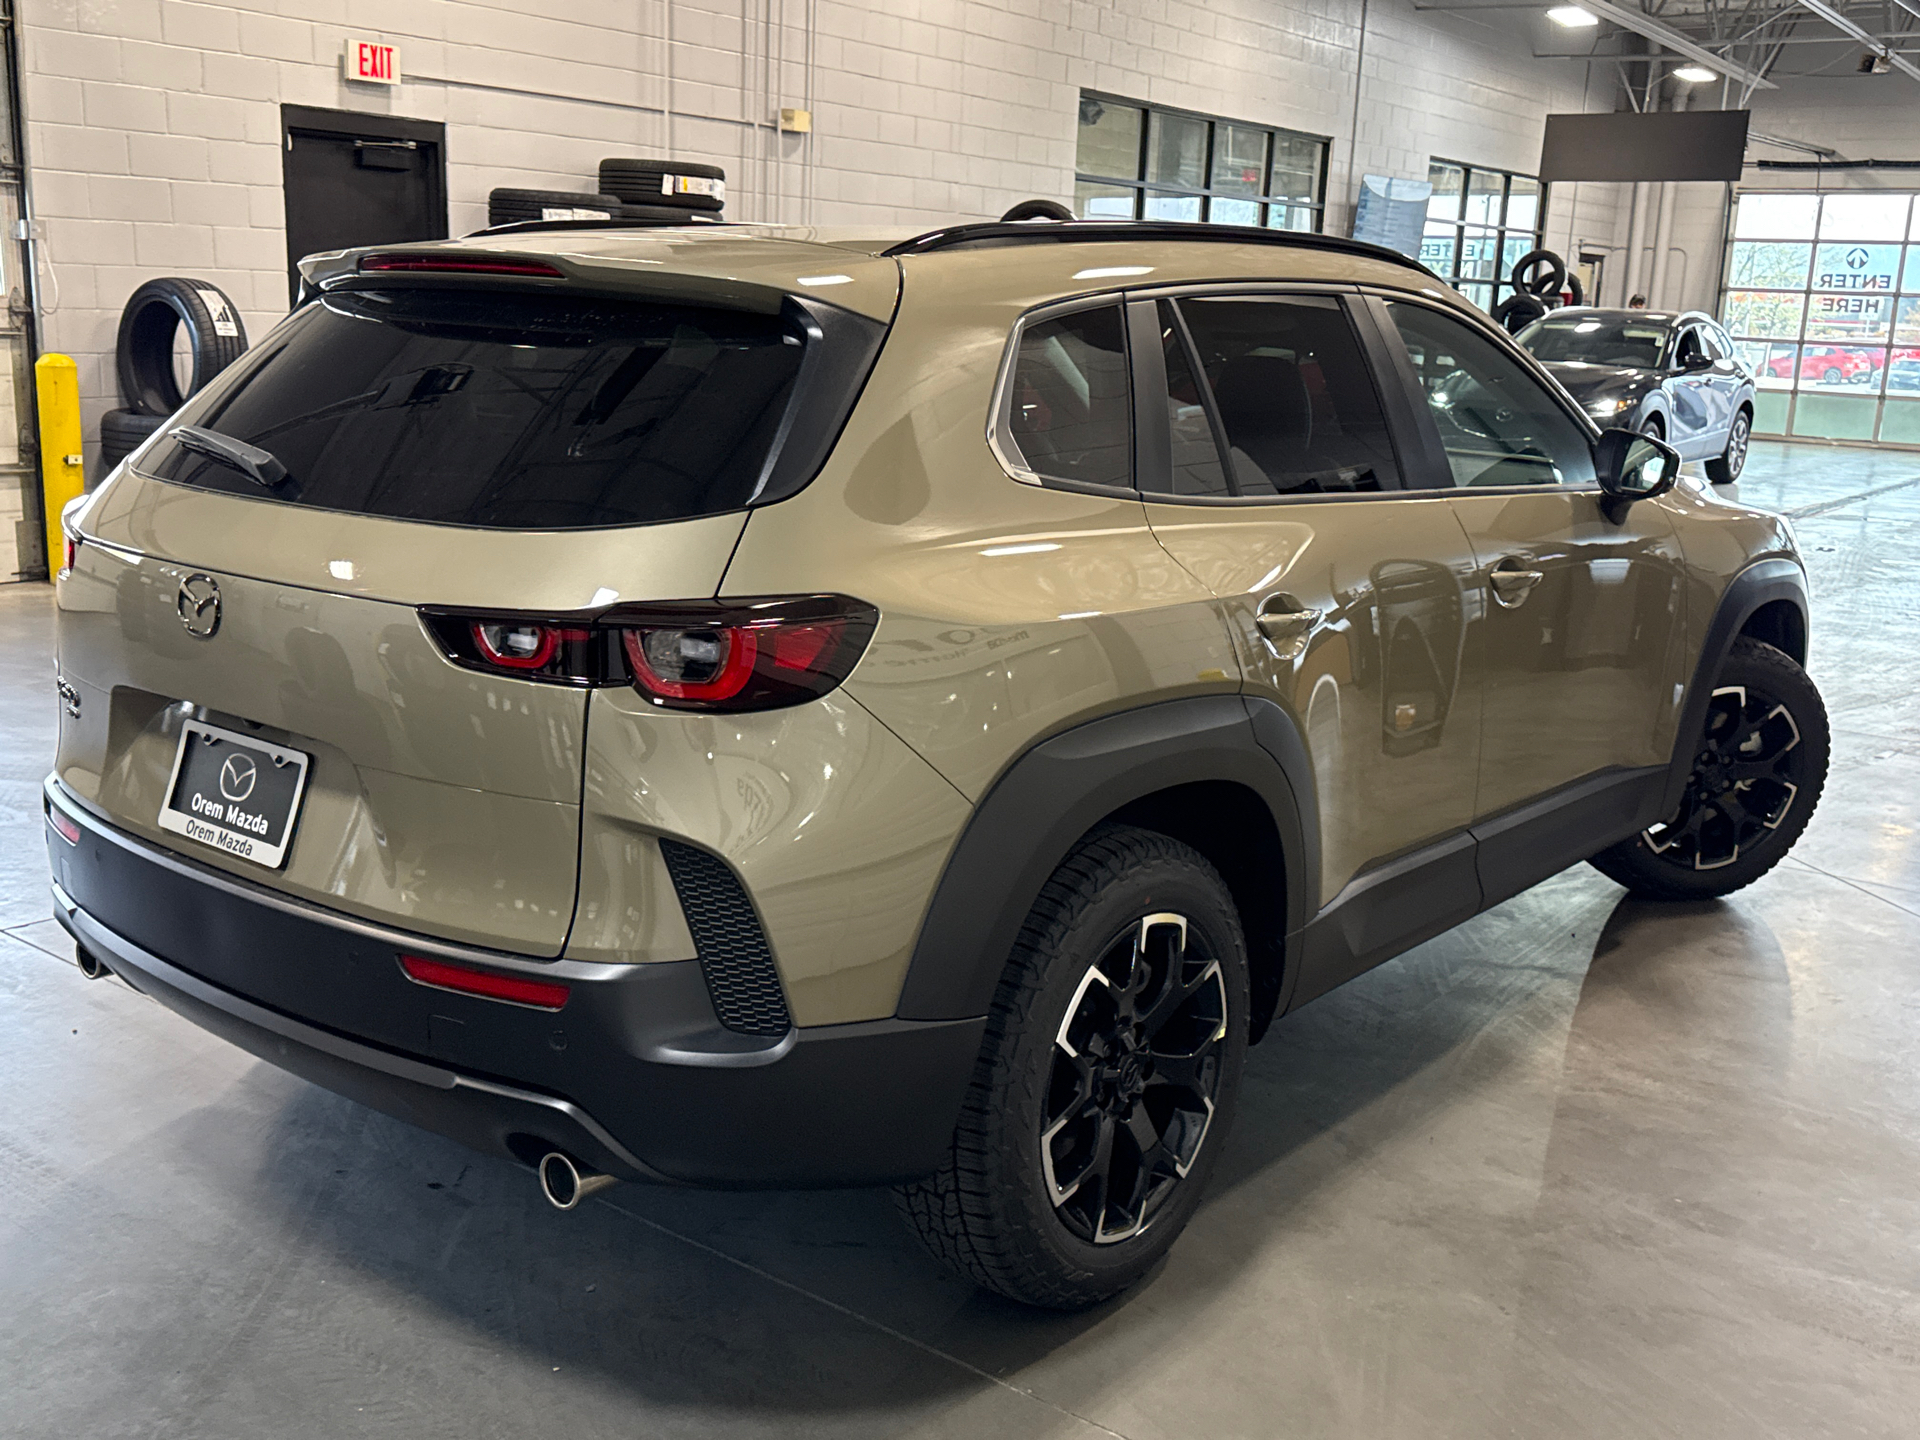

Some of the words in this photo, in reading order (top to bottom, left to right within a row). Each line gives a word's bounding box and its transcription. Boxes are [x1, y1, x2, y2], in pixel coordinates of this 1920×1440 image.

[359, 43, 393, 80] EXIT
[191, 792, 224, 820] Orem
[225, 804, 269, 835] Mazda
[186, 819, 215, 843] Orem
[216, 830, 253, 856] Mazda
